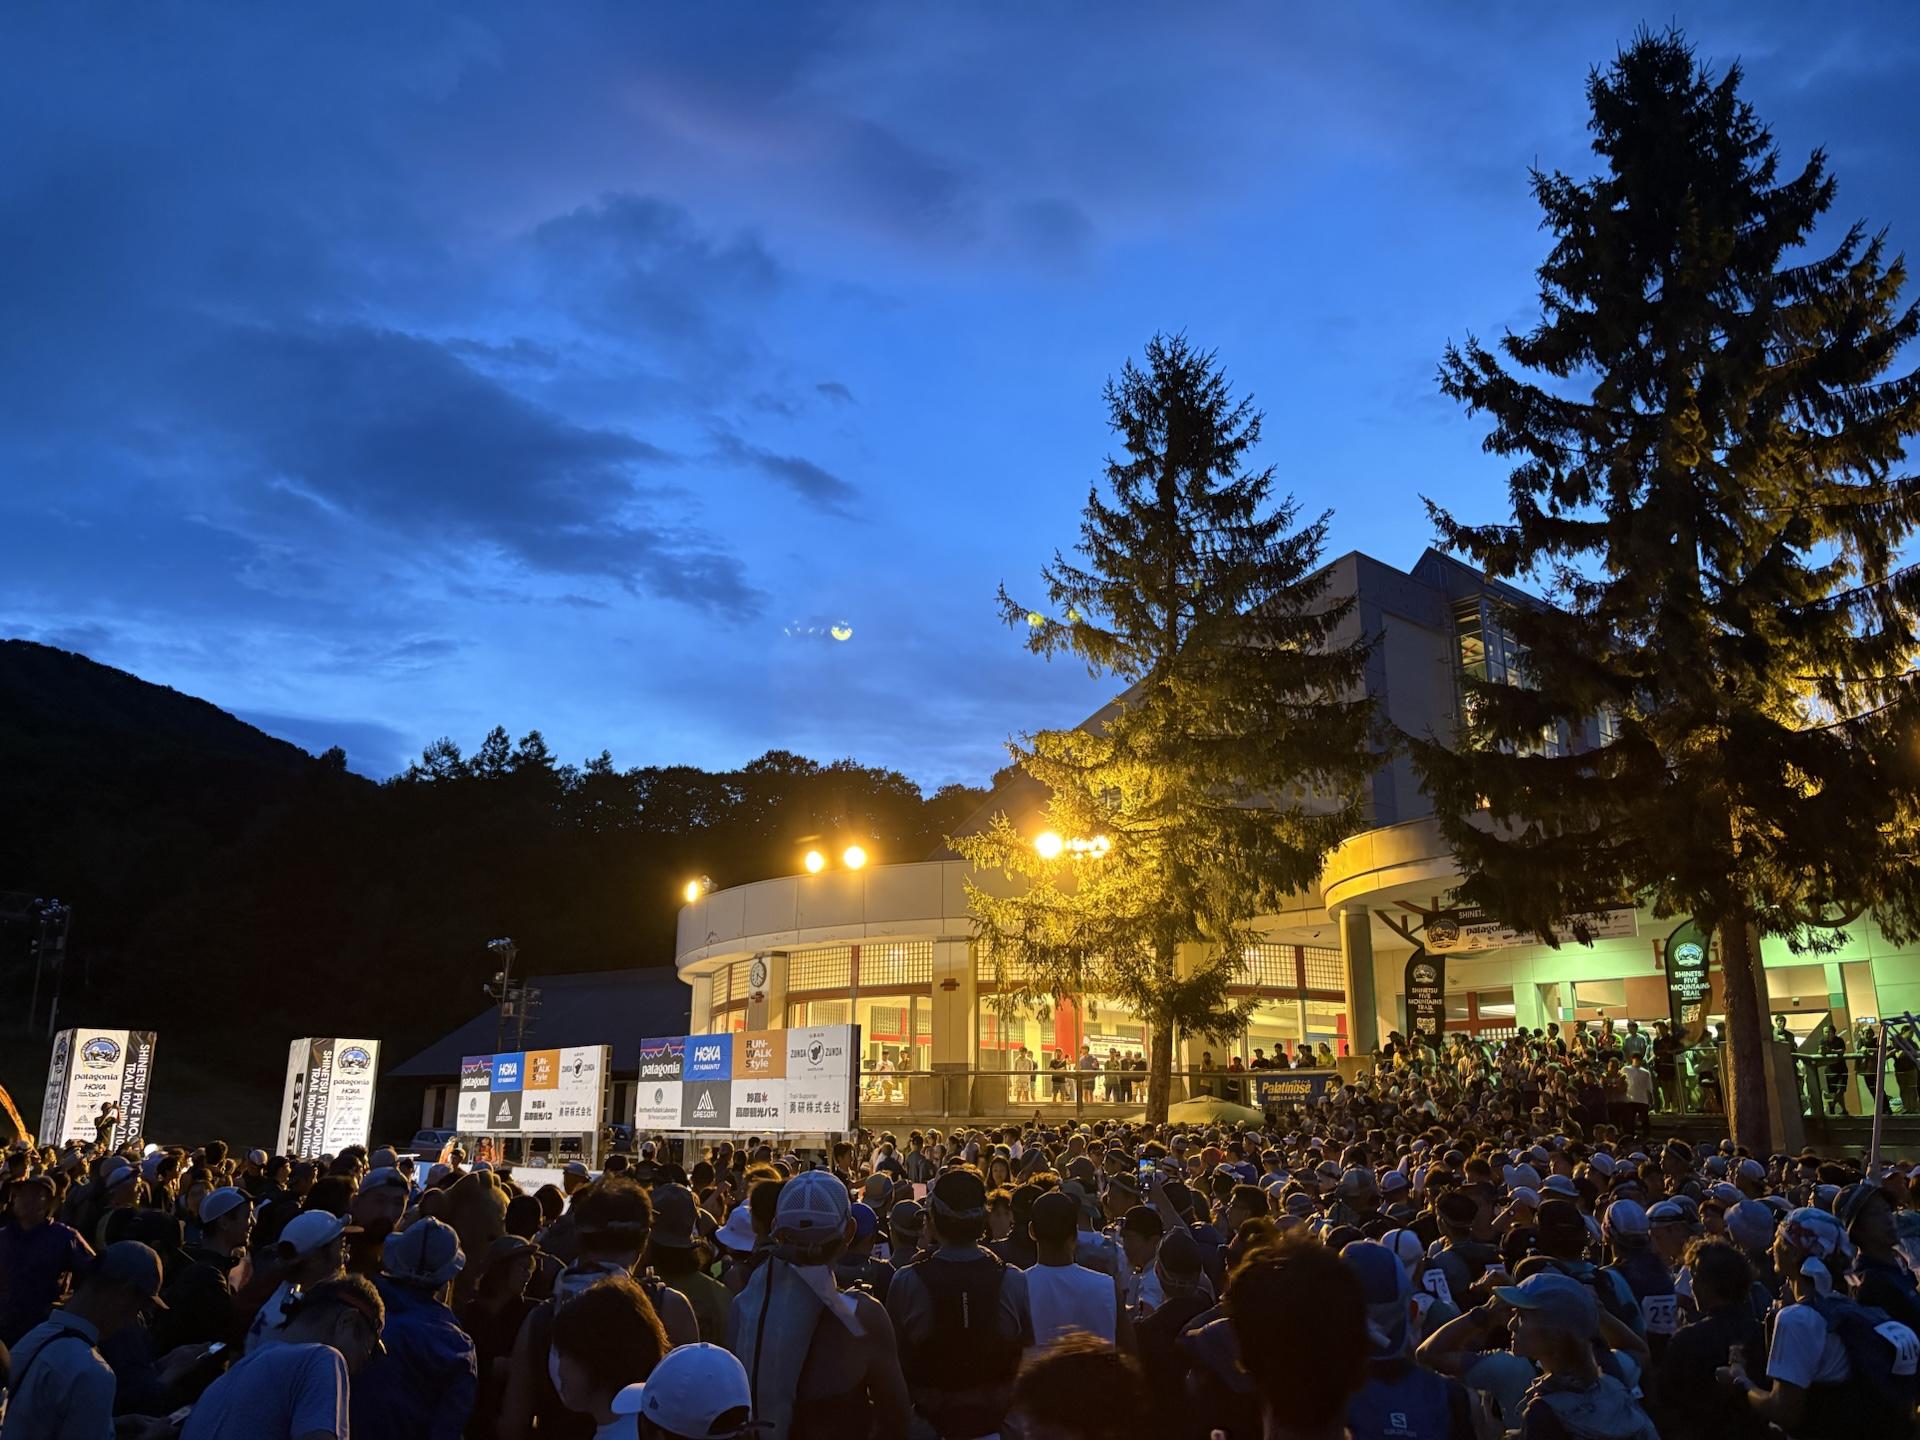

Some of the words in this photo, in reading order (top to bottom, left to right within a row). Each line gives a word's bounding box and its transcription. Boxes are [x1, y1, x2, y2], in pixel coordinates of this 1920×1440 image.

[694, 1046, 721, 1062] HOKA
[746, 1048, 773, 1058] WALK
[134, 1044, 150, 1090] SHINETSU
[319, 1050, 333, 1093] SHINETSU
[498, 1062, 517, 1076] HOKA
[641, 1061, 680, 1077] patagonia
[745, 1058, 769, 1070] Style
[74, 1073, 118, 1082] patagonia
[123, 1062, 137, 1090] TRAIL
[308, 1067, 320, 1093] TRAIL
[462, 1076, 490, 1088] patagonia
[131, 1092, 144, 1115] FIVE
[316, 1094, 328, 1116] FIVE
[692, 1110, 718, 1119] GREGORY
